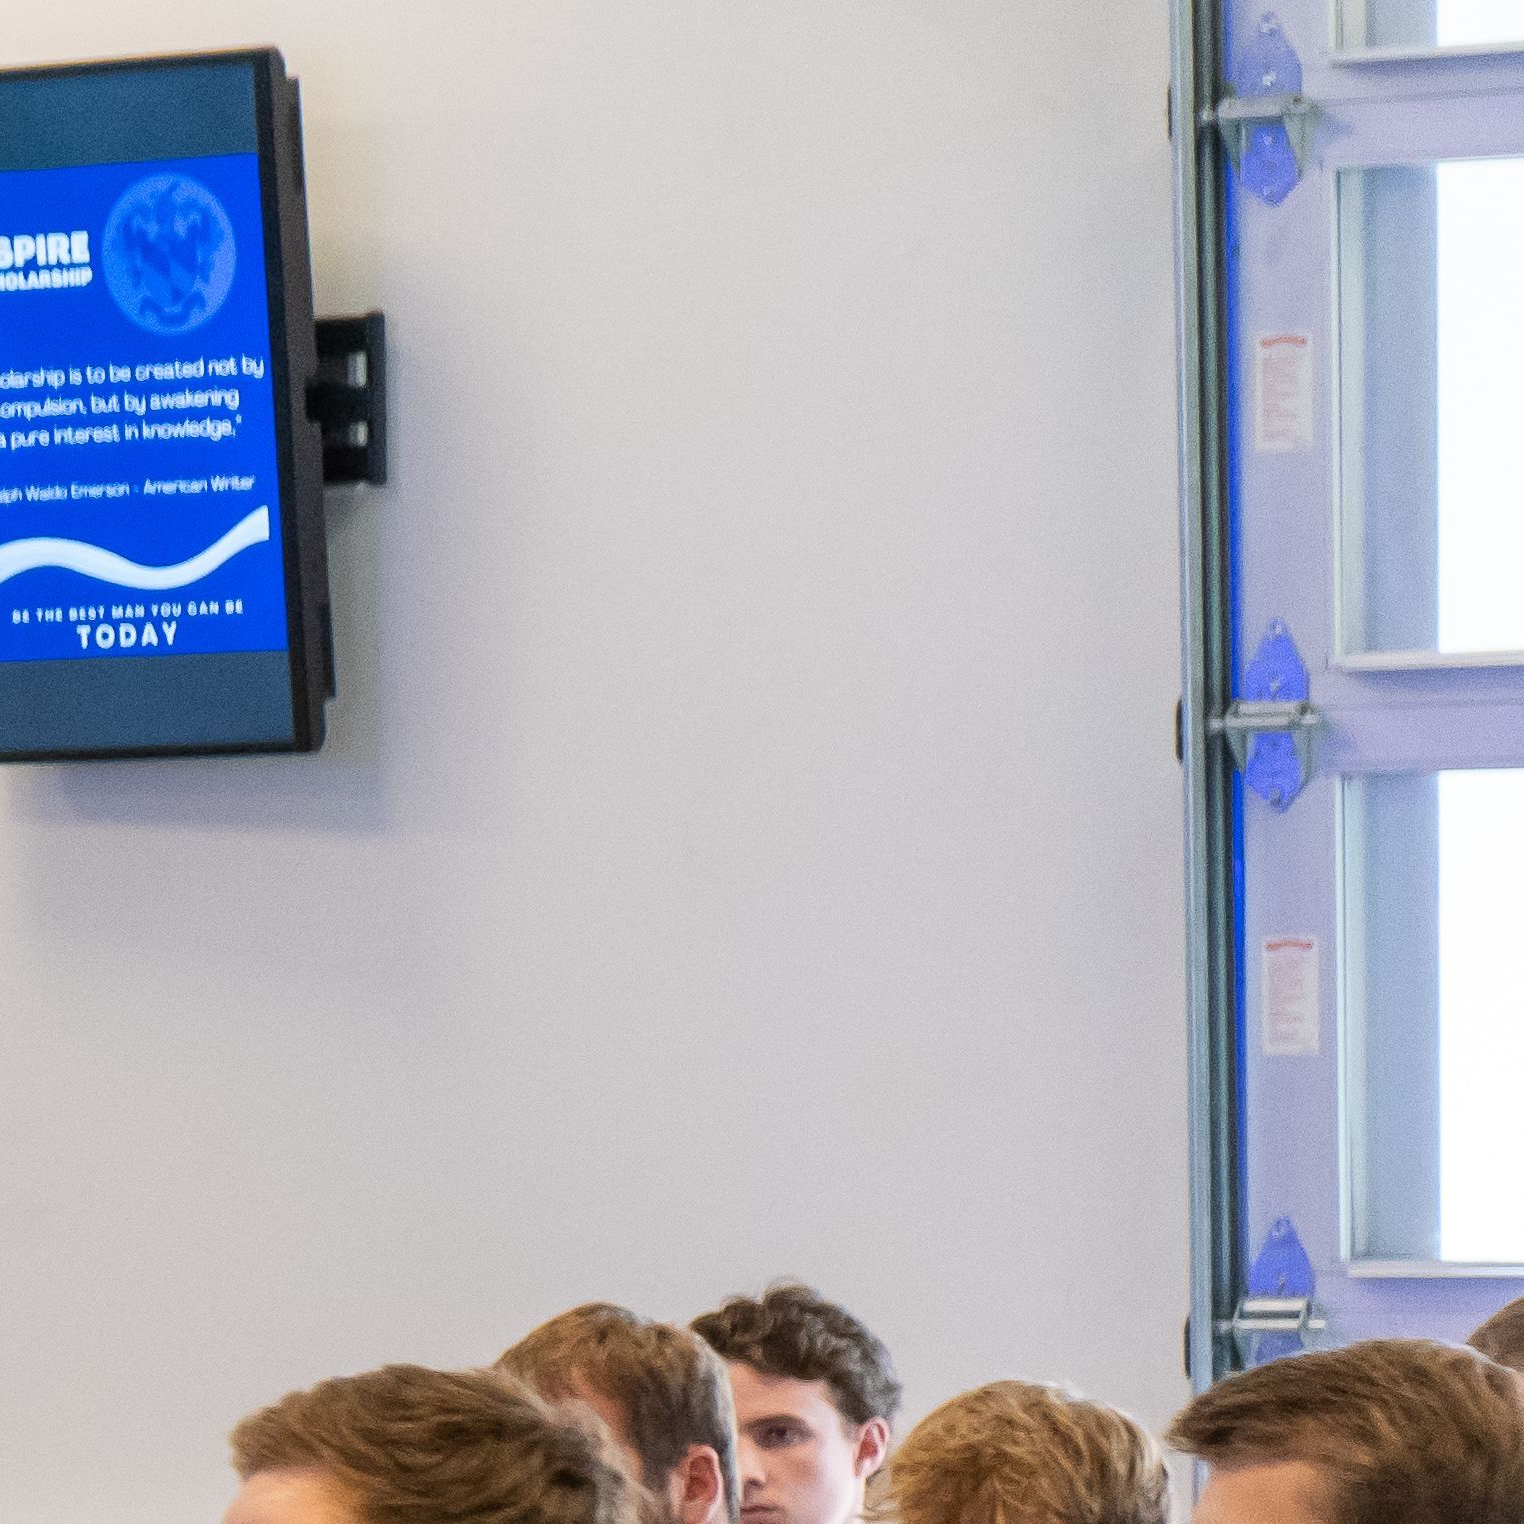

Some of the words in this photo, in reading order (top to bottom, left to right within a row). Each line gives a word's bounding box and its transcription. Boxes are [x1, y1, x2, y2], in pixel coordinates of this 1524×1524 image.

[69, 365, 82, 385] is
[86, 364, 105, 384] to
[109, 361, 131, 383] be
[135, 356, 204, 382] created
[208, 354, 238, 377] not
[242, 353, 264, 379] by
[91, 392, 120, 413] but
[124, 390, 146, 416] by
[150, 386, 239, 410] awakening
[11, 429, 50, 452] pure
[54, 424, 120, 445] interest
[124, 422, 139, 441] in
[77, 620, 177, 650] TODAY
